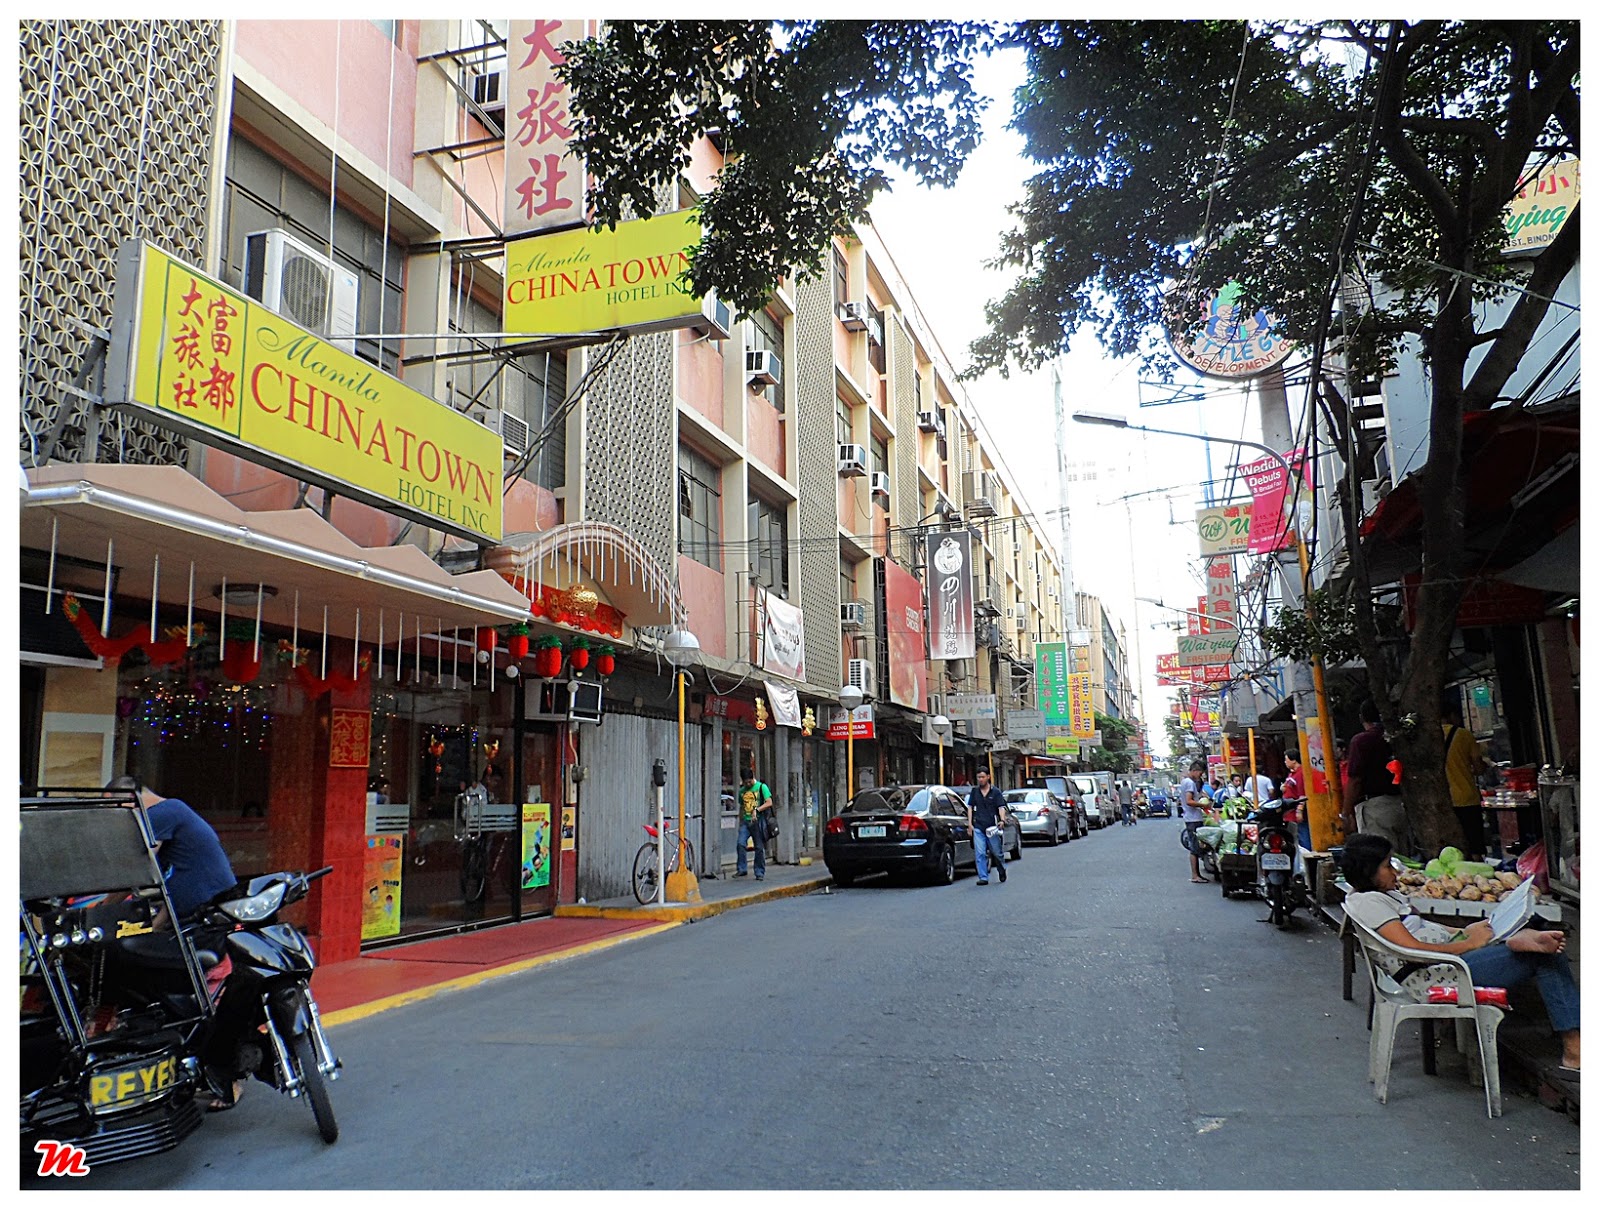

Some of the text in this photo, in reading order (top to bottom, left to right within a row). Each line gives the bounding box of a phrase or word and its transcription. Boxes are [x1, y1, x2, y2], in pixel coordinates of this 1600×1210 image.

[1506, 205, 1567, 239] ying
[506, 251, 691, 304] CHINATOWN
[508, 246, 591, 277] Manila
[606, 282, 661, 306] HOTEL
[172, 278, 204, 410] 大旅社
[201, 294, 238, 422] 富都
[256, 326, 381, 405] Manila
[1194, 351, 1277, 374] DEVELOPMENT
[251, 362, 495, 508] CHINATOWN
[1248, 470, 1281, 487] Debuts
[397, 478, 494, 536] HOTEL INC.
[1180, 639, 1206, 654] Wai
[90, 1056, 176, 1108] REYES
